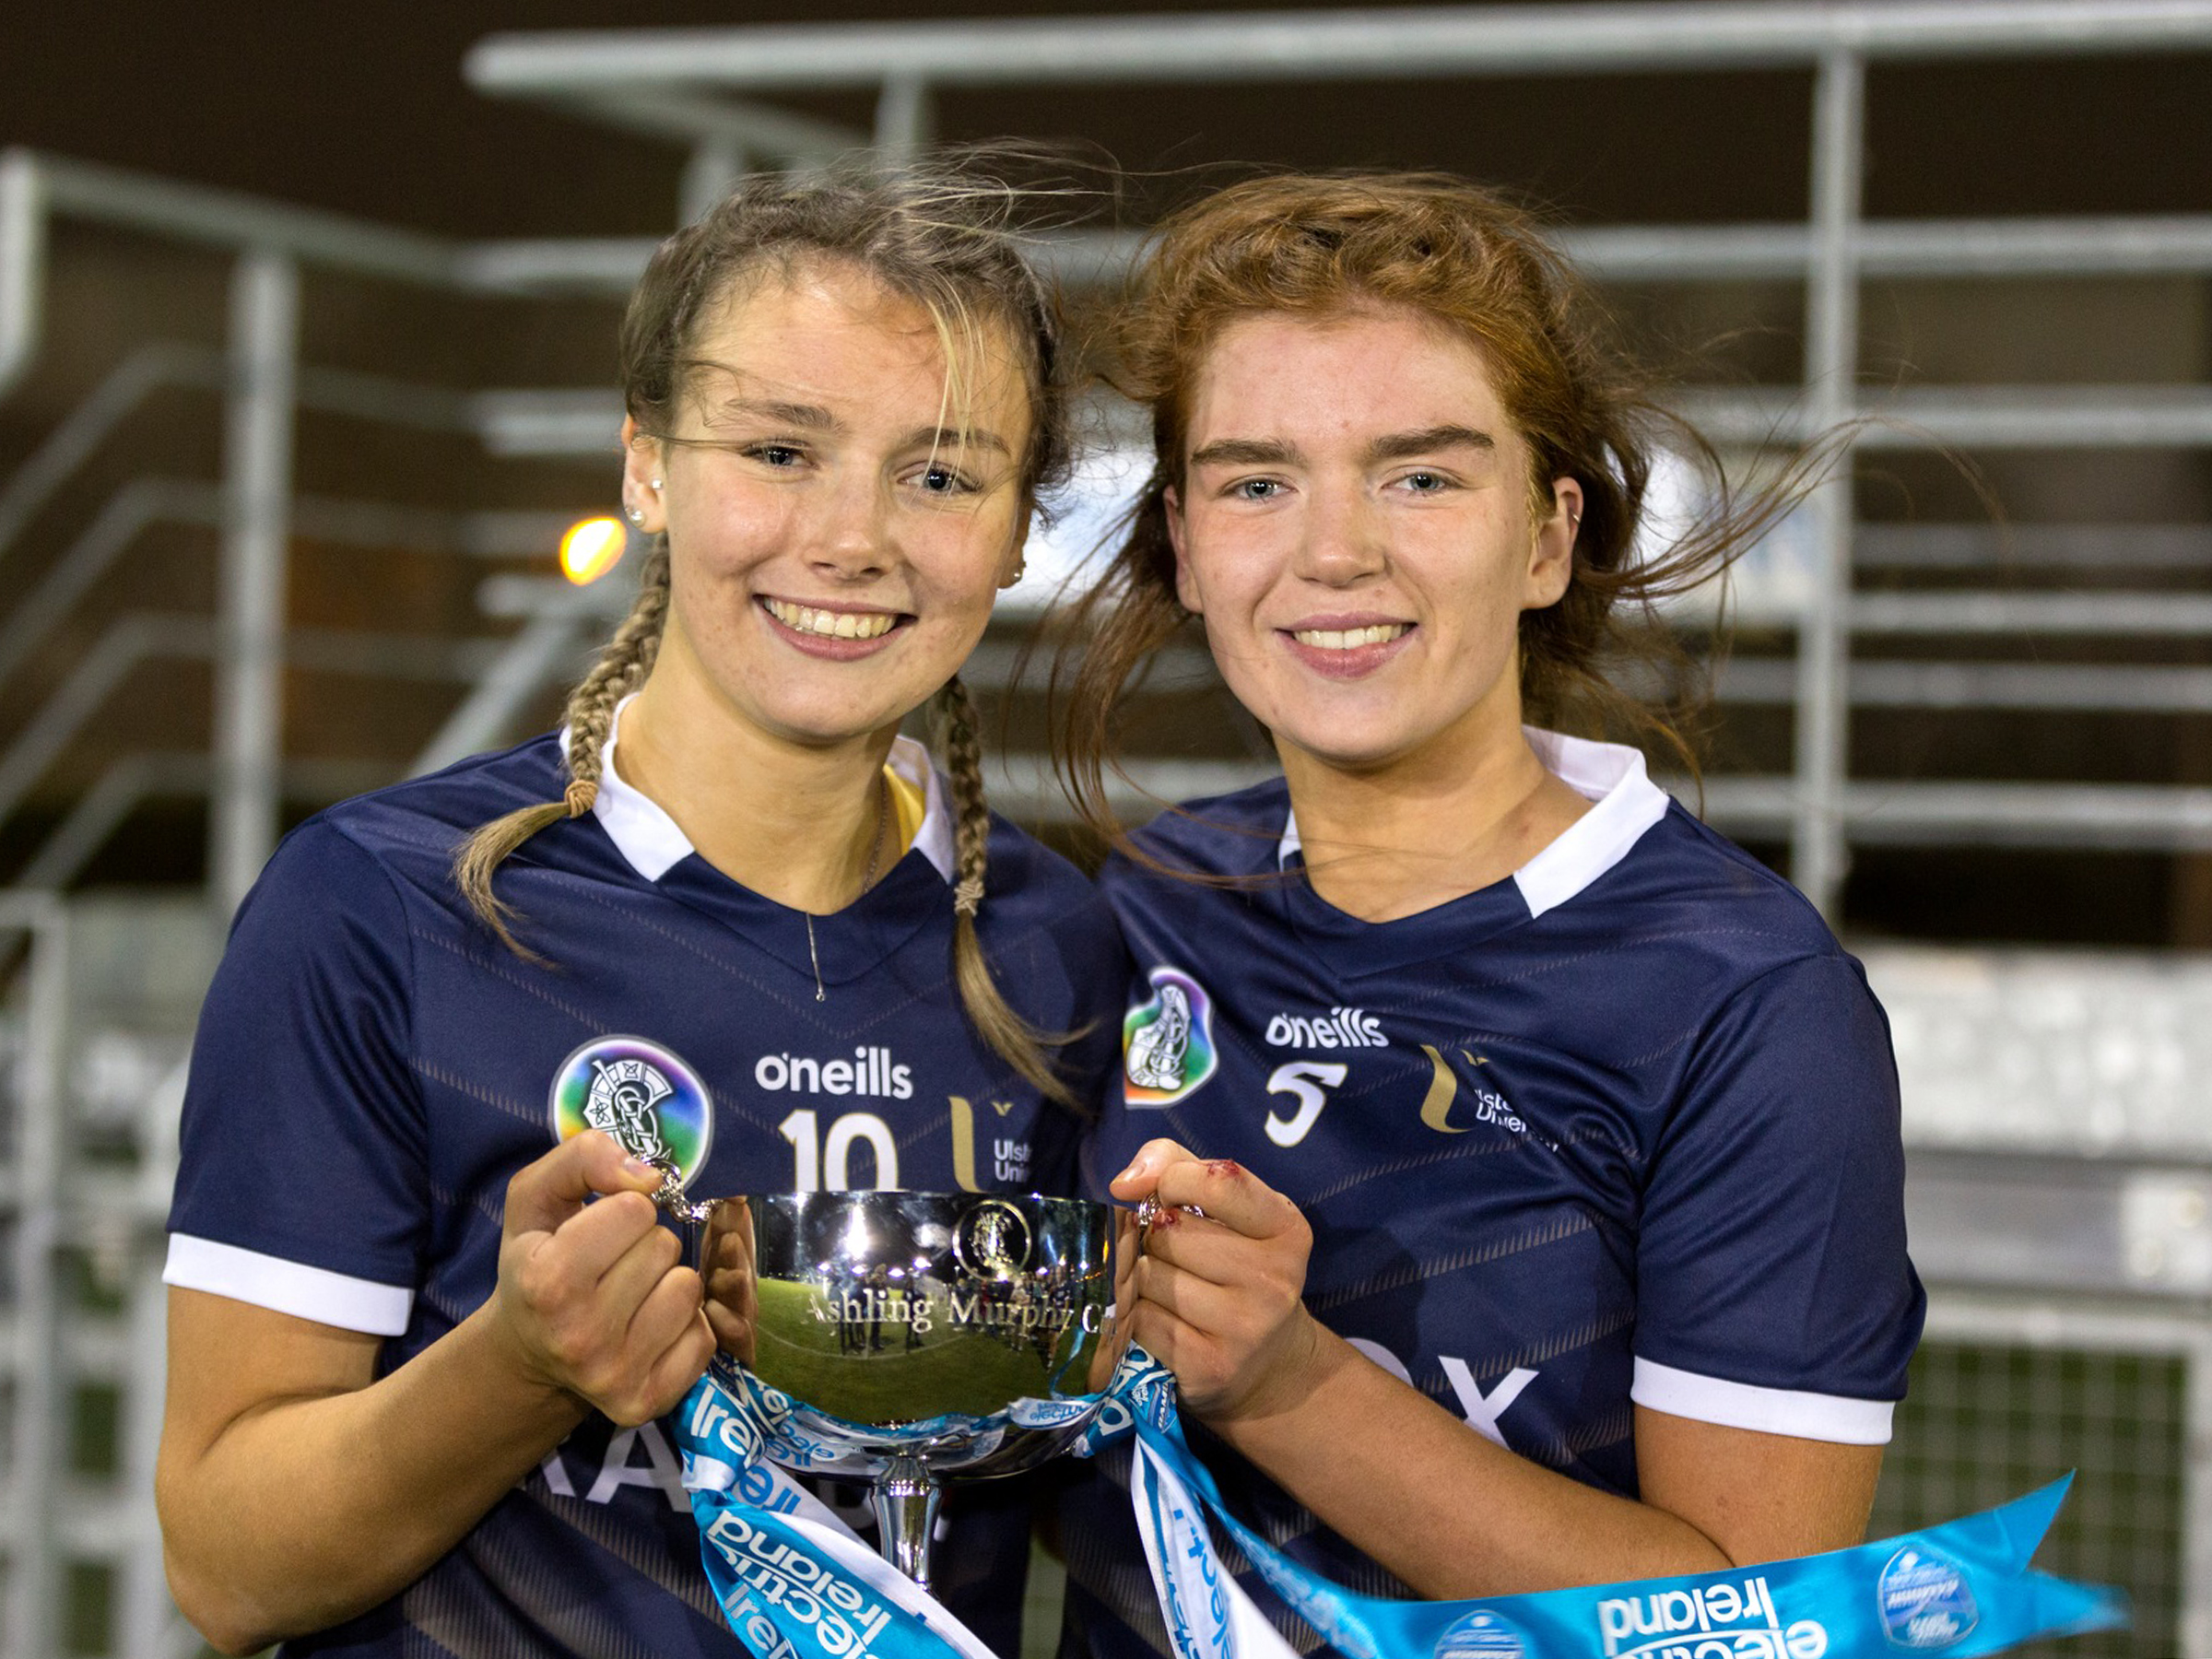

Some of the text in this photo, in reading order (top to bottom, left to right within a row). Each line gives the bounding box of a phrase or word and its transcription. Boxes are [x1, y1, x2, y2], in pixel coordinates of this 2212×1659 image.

[1264, 1061, 1347, 1147] 5
[778, 1109, 899, 1192] 10
[947, 1292, 1075, 1338] Murphy
[707, 1509, 892, 1645] Ireland
[1598, 1577, 1780, 1657] Ireland
